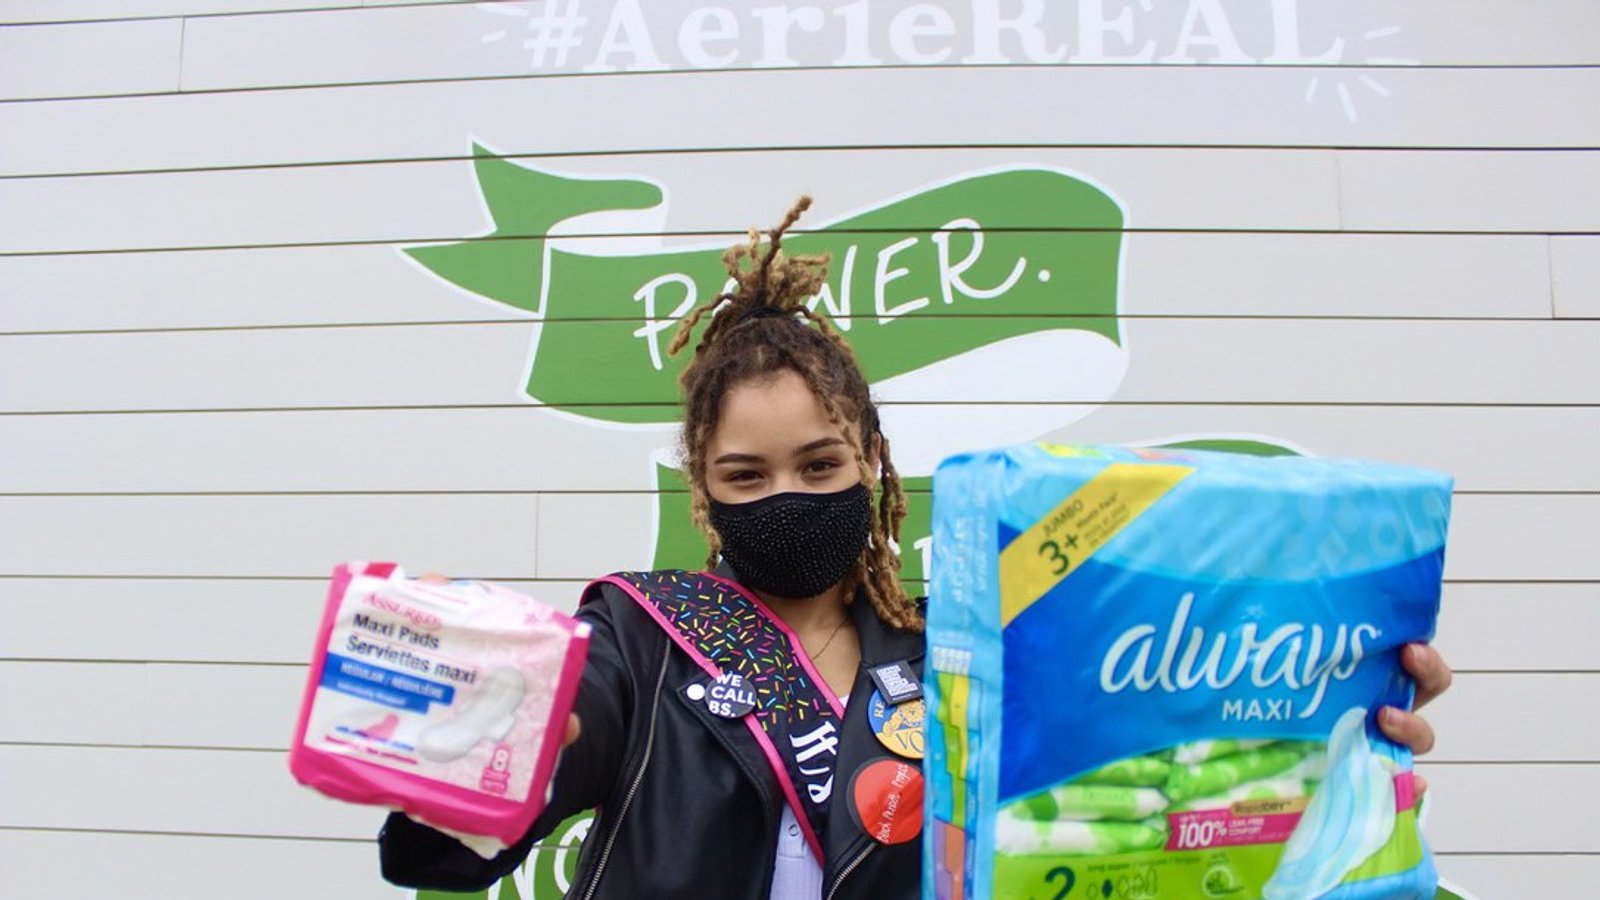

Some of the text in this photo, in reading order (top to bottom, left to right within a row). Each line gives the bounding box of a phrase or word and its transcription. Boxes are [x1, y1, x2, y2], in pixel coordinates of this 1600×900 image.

[523, 0, 1344, 72] #AerieREAL
[633, 217, 1051, 370] PWER.
[1043, 498, 1083, 537] JUMBO
[1038, 532, 1079, 576] 3+
[353, 613, 440, 649] Maxi Pads
[346, 634, 477, 685] Serviettes maxi
[1100, 591, 1378, 719] always
[711, 685, 756, 706] CALL
[716, 673, 743, 687] WE
[708, 700, 736, 718] BS.
[1221, 699, 1293, 721] MAXI
[492, 747, 508, 773] 8
[1177, 820, 1228, 849] 100%
[1043, 865, 1077, 900] 2
